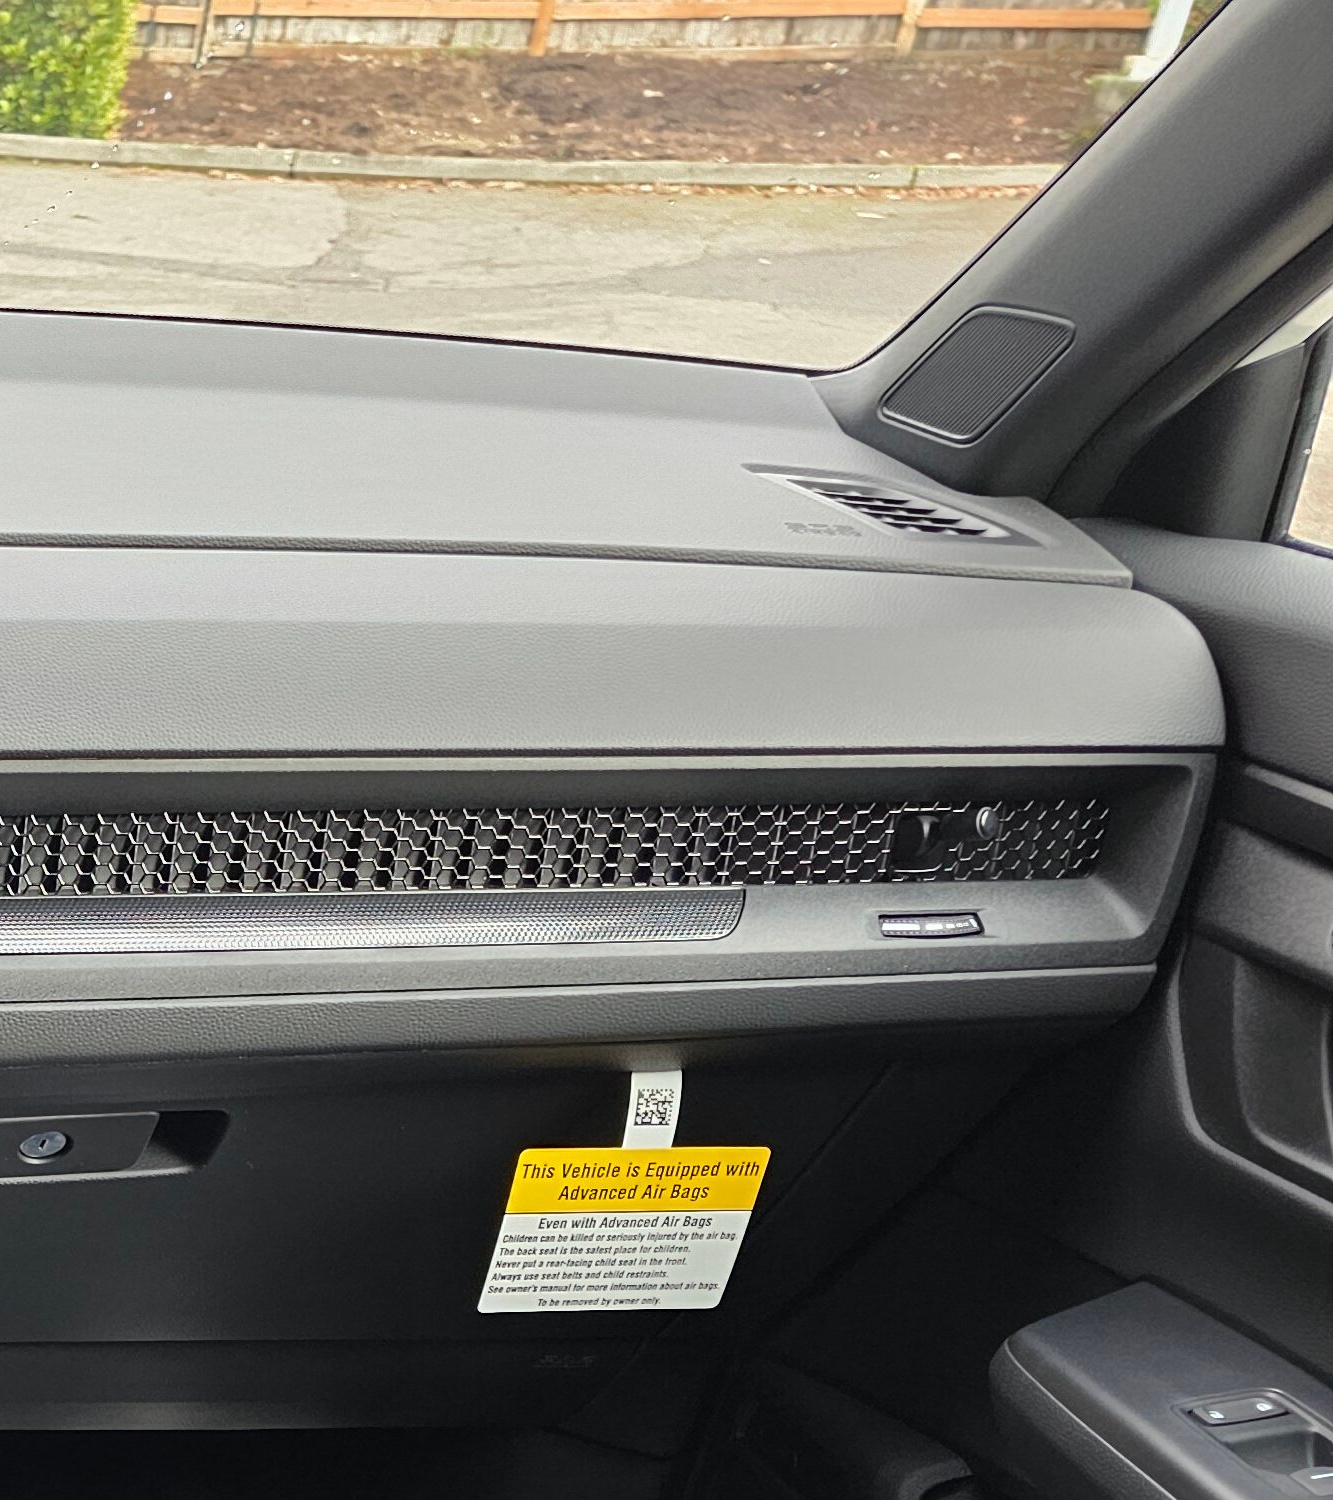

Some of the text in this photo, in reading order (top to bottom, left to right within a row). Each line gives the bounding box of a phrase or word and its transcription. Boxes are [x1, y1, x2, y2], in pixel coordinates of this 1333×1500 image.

[523, 1161, 760, 1180] This Vehicle is Equipped with
[558, 1184, 710, 1201] Advanced Air Bags
[538, 1215, 712, 1229] Even with Advanced Air Bags
[503, 1234, 537, 1243] Children
[540, 1235, 555, 1243] can
[557, 1234, 568, 1243] be
[570, 1233, 593, 1243] killed
[606, 1233, 644, 1243] seriously
[647, 1232, 677, 1242] injured
[679, 1232, 688, 1242] by
[690, 1231, 704, 1240] the
[706, 1231, 718, 1240] air
[499, 1247, 514, 1256] The
[517, 1247, 536, 1256] back
[539, 1247, 557, 1255] seat
[495, 1260, 521, 1269] Never
[522, 1260, 537, 1269] put
[595, 1258, 616, 1267] child
[491, 1273, 521, 1281] Always
[488, 1286, 503, 1294] See
